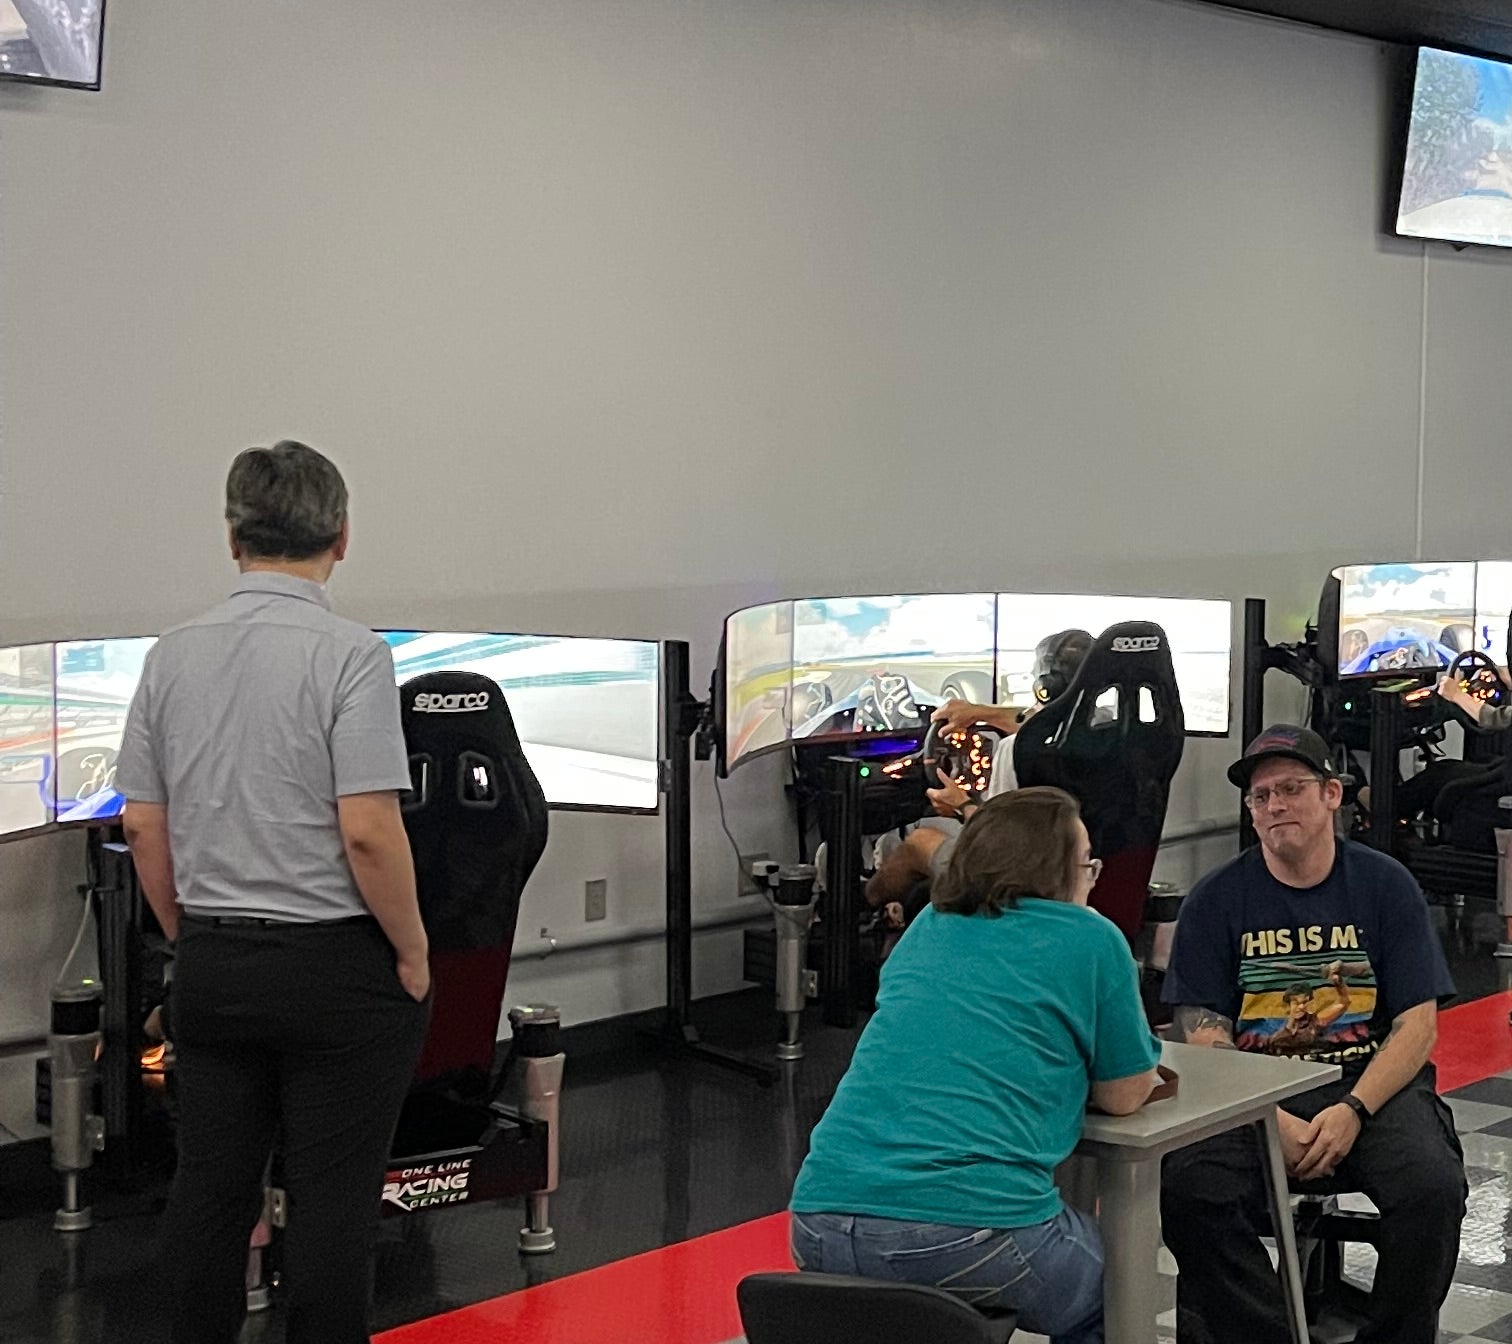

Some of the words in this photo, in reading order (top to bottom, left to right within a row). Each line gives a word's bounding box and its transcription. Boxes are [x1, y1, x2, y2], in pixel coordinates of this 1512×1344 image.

[413, 691, 490, 713] sparco
[1298, 925, 1323, 952] IS
[1330, 924, 1363, 949] M
[401, 1165, 434, 1179] ONE
[437, 1158, 473, 1173] LINE
[381, 1171, 470, 1212] RACING
[409, 1191, 470, 1209] CENTER
